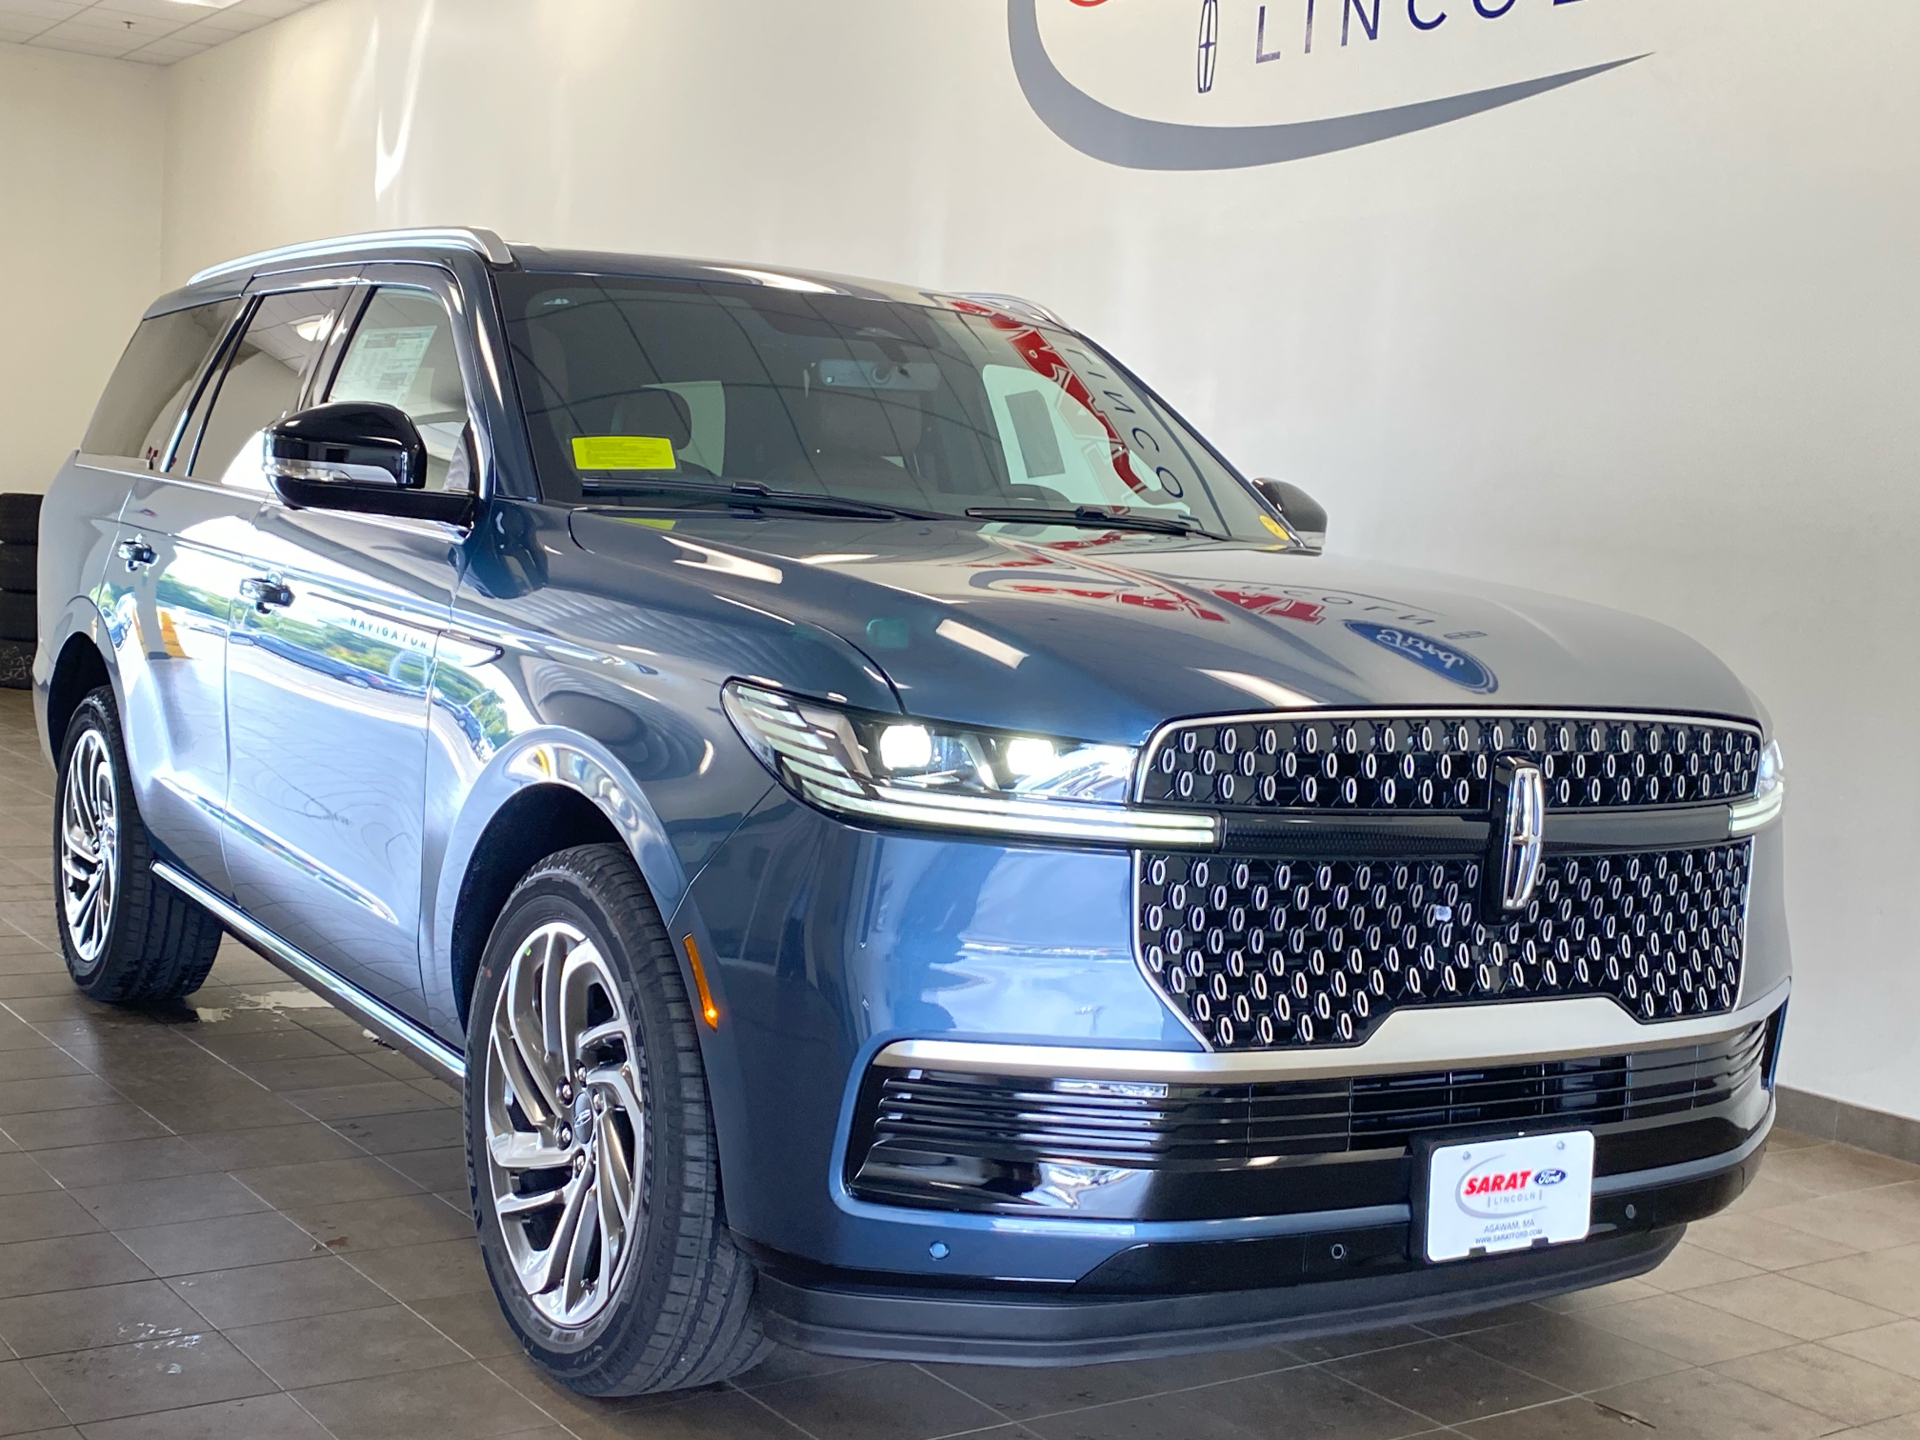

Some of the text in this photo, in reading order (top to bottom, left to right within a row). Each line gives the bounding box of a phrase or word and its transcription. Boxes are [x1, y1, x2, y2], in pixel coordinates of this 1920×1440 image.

[1256, 0, 1588, 64] LINC
[350, 617, 428, 649] NAVIGATOR
[1464, 1169, 1532, 1196] SARAT
[1494, 1192, 1535, 1205] LINCOLN
[1475, 1229, 1542, 1243] WWW.SARATFORD.COM
[1484, 1218, 1535, 1234] AGAWAM, MA
